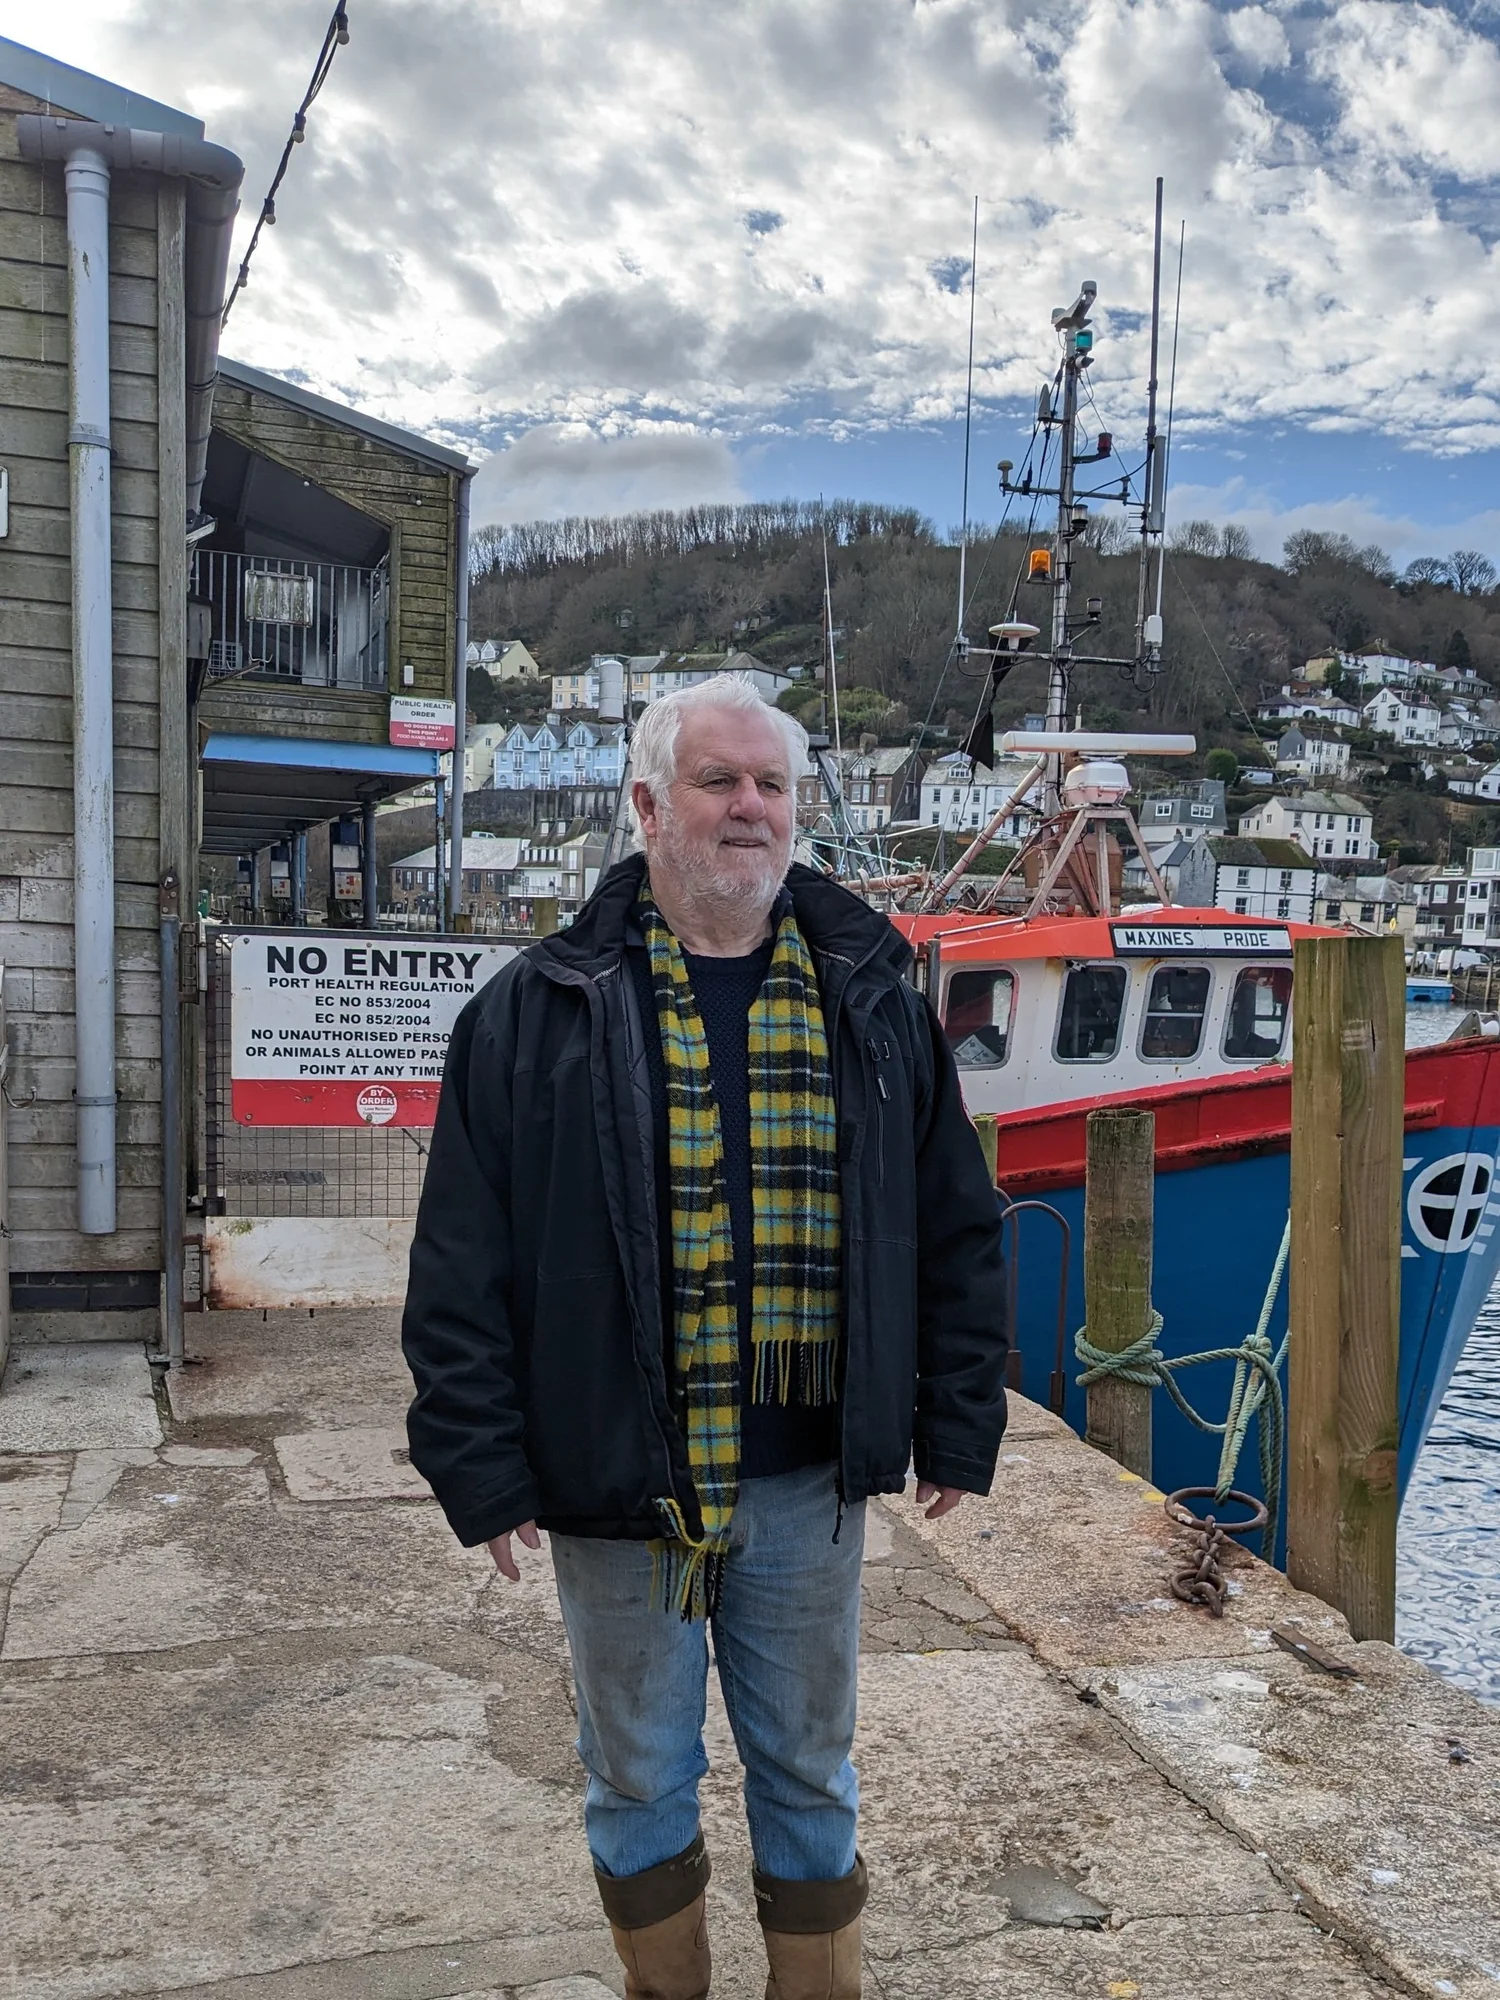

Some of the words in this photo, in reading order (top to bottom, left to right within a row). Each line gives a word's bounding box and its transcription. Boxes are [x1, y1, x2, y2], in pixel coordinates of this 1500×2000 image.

[1125, 931, 1194, 946] MAXINES
[1224, 932, 1270, 947] PRIDE
[266, 945, 328, 975] NO
[343, 948, 483, 980] ENTRY
[269, 977, 310, 989] PORT
[315, 978, 375, 991] HEALTH
[379, 980, 475, 994] REGULATION
[315, 996, 335, 1007] EC
[339, 996, 362, 1008] NO
[366, 997, 431, 1009] 853/2004
[315, 1013, 335, 1024] EC
[339, 1013, 362, 1025] NO
[366, 1014, 431, 1026] 852/2004
[251, 1029, 274, 1040] NO
[278, 1029, 399, 1043] UNAUTHORISED
[403, 1032, 450, 1043] PERSO
[245, 1047, 268, 1058] OR
[271, 1047, 341, 1059] ANIMALS
[345, 1048, 416, 1060] ALLOWED
[421, 1049, 447, 1060] PAS
[299, 1064, 346, 1076] POINT
[350, 1065, 370, 1076] AT
[373, 1065, 405, 1077] ANY
[409, 1066, 444, 1077] TIME
[370, 1089, 384, 1097] BY
[360, 1097, 394, 1105] ORDER
